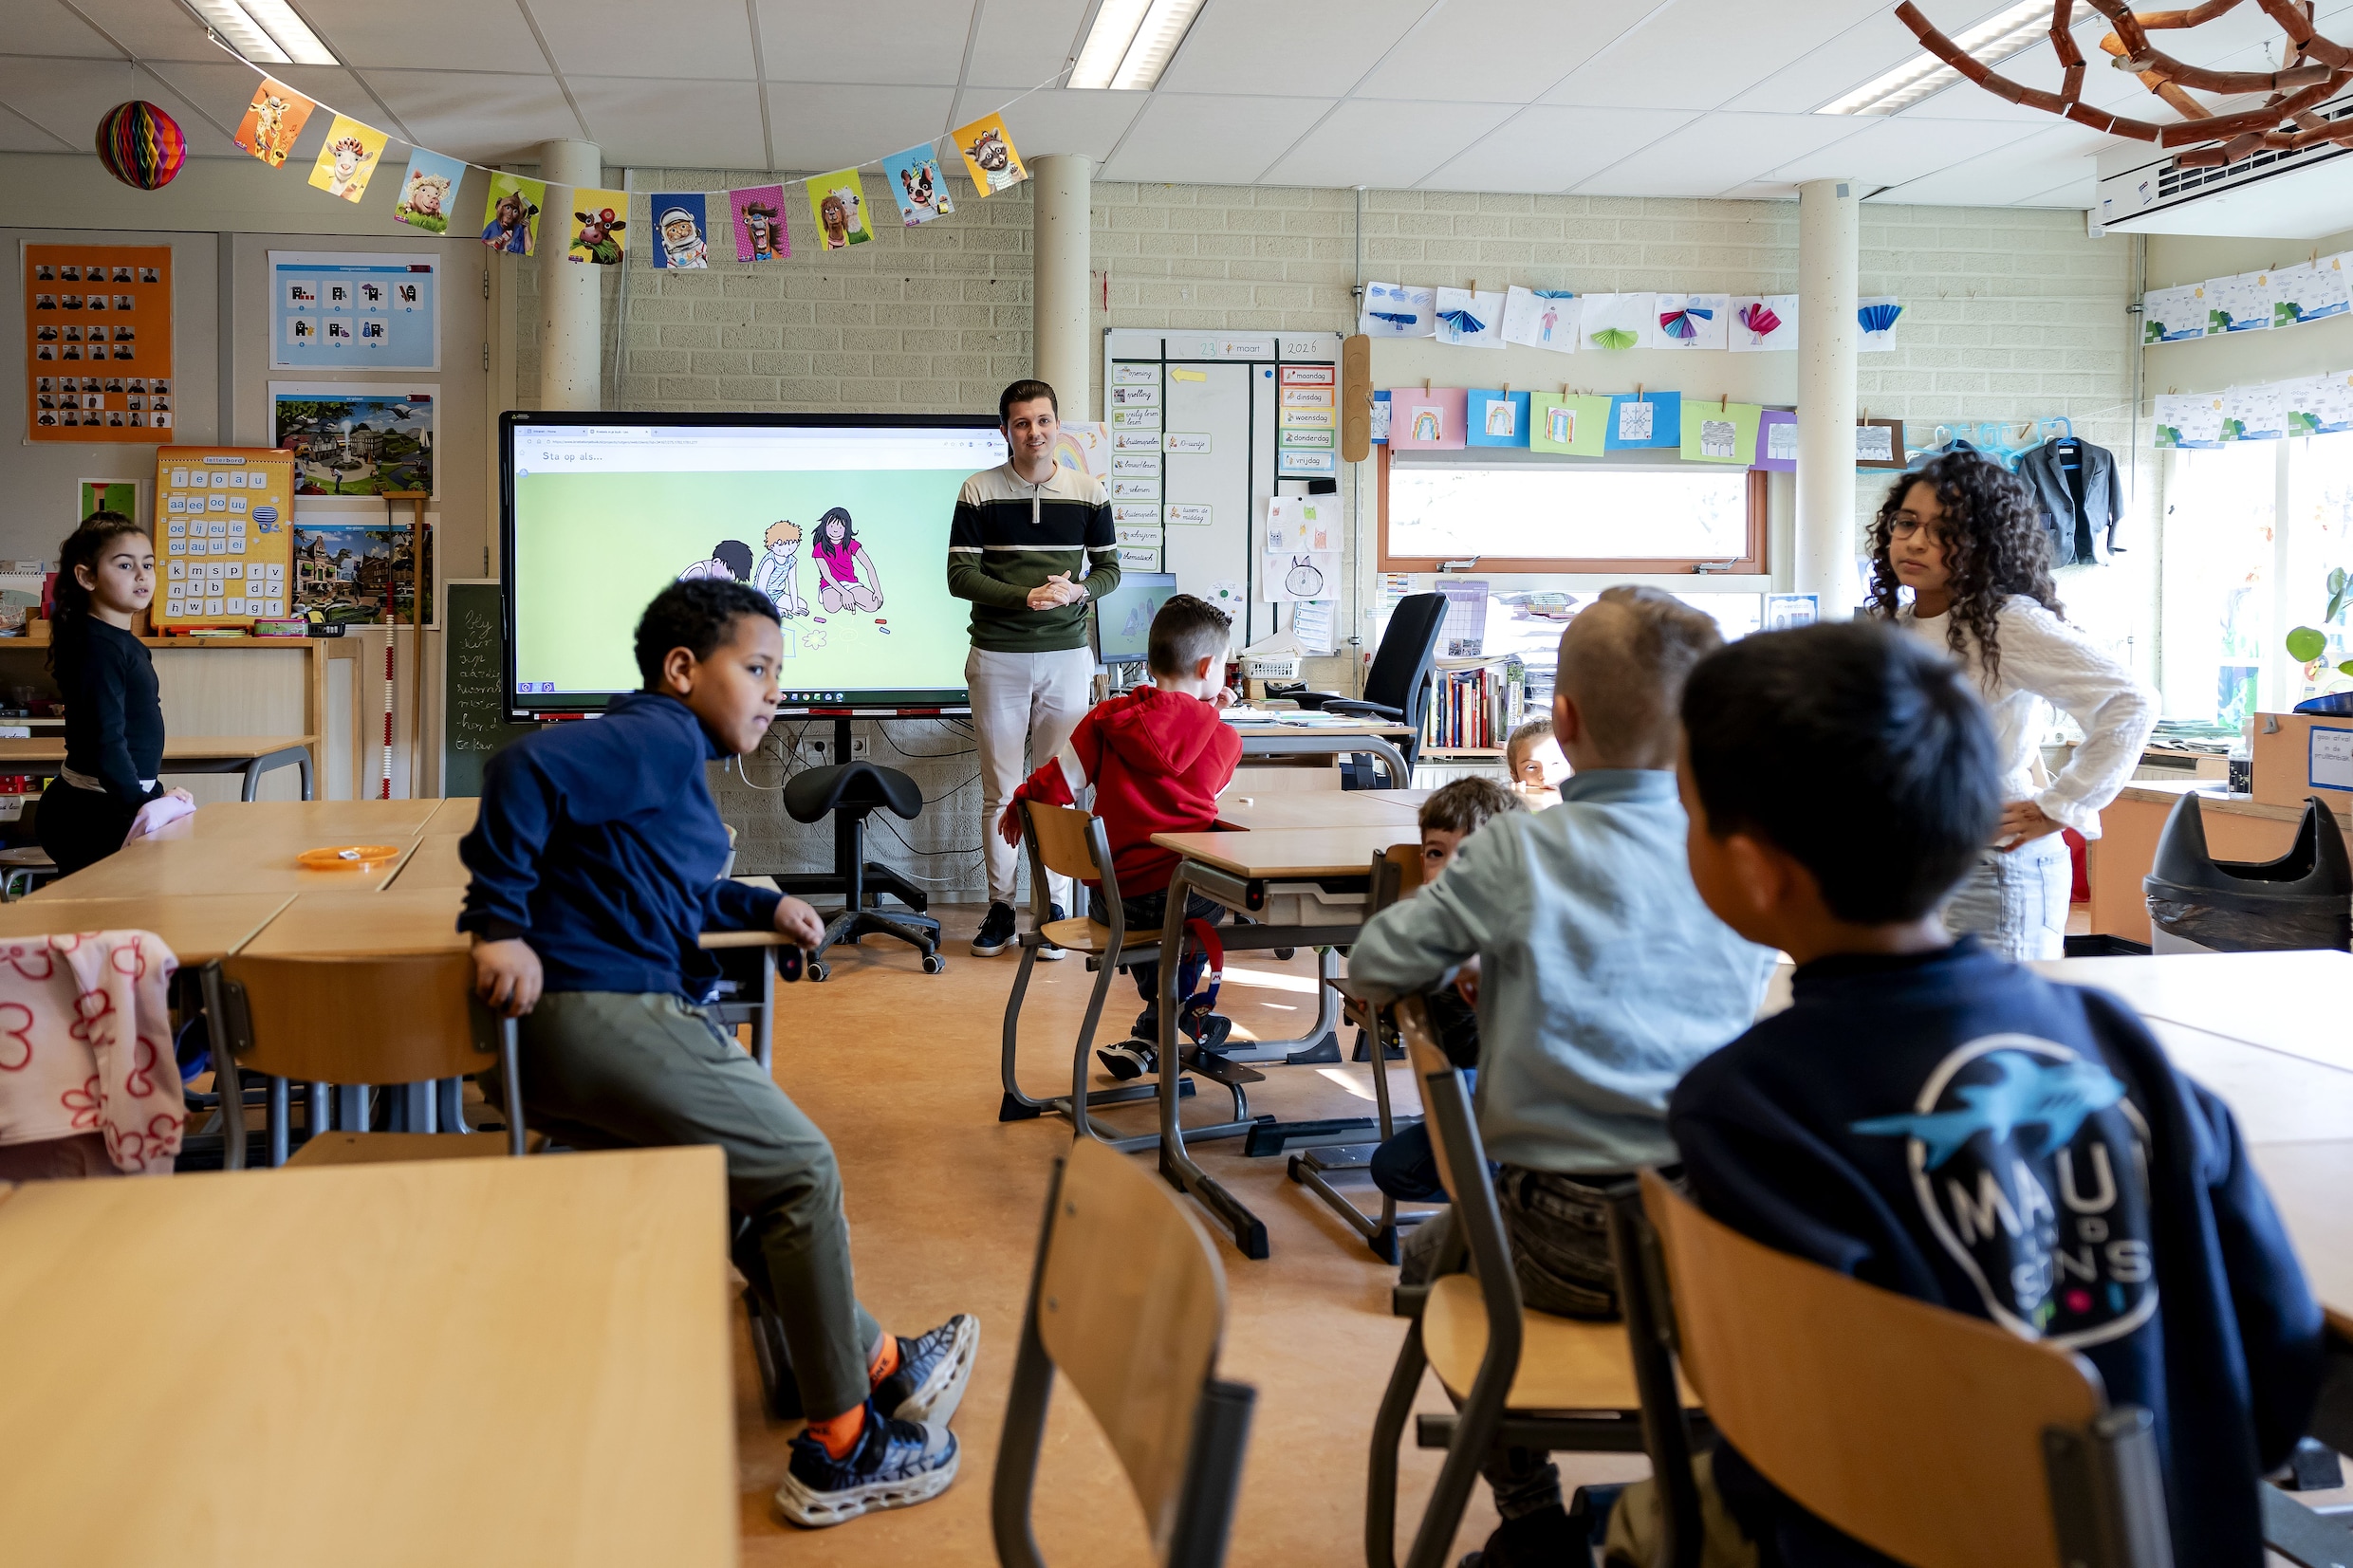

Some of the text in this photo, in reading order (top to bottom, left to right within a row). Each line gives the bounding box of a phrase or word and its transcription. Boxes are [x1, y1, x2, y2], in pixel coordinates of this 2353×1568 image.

[1200, 342, 1216, 357] 23
[1288, 340, 1317, 355] 2026
[1128, 371, 1152, 380] opening
[1296, 373, 1325, 381] maandag
[1127, 389, 1152, 400] spelling
[1296, 394, 1322, 402] dinsdag
[1296, 415, 1328, 423] woensdag
[1294, 434, 1329, 443] donderdag
[543, 452, 602, 462] Sta op als...
[1296, 457, 1321, 466] vrijdag
[1183, 515, 1204, 525] middag
[195, 523, 202, 534] ij
[232, 524, 243, 532] ie
[213, 542, 223, 550] ui
[232, 540, 242, 548] ei
[1123, 552, 1154, 562] thematisch
[174, 566, 180, 575] k
[231, 566, 238, 576] p
[195, 583, 198, 592] t
[212, 582, 219, 591] b
[251, 584, 258, 593] d
[172, 603, 178, 612] h
[213, 602, 216, 612] j
[272, 603, 277, 612] f
